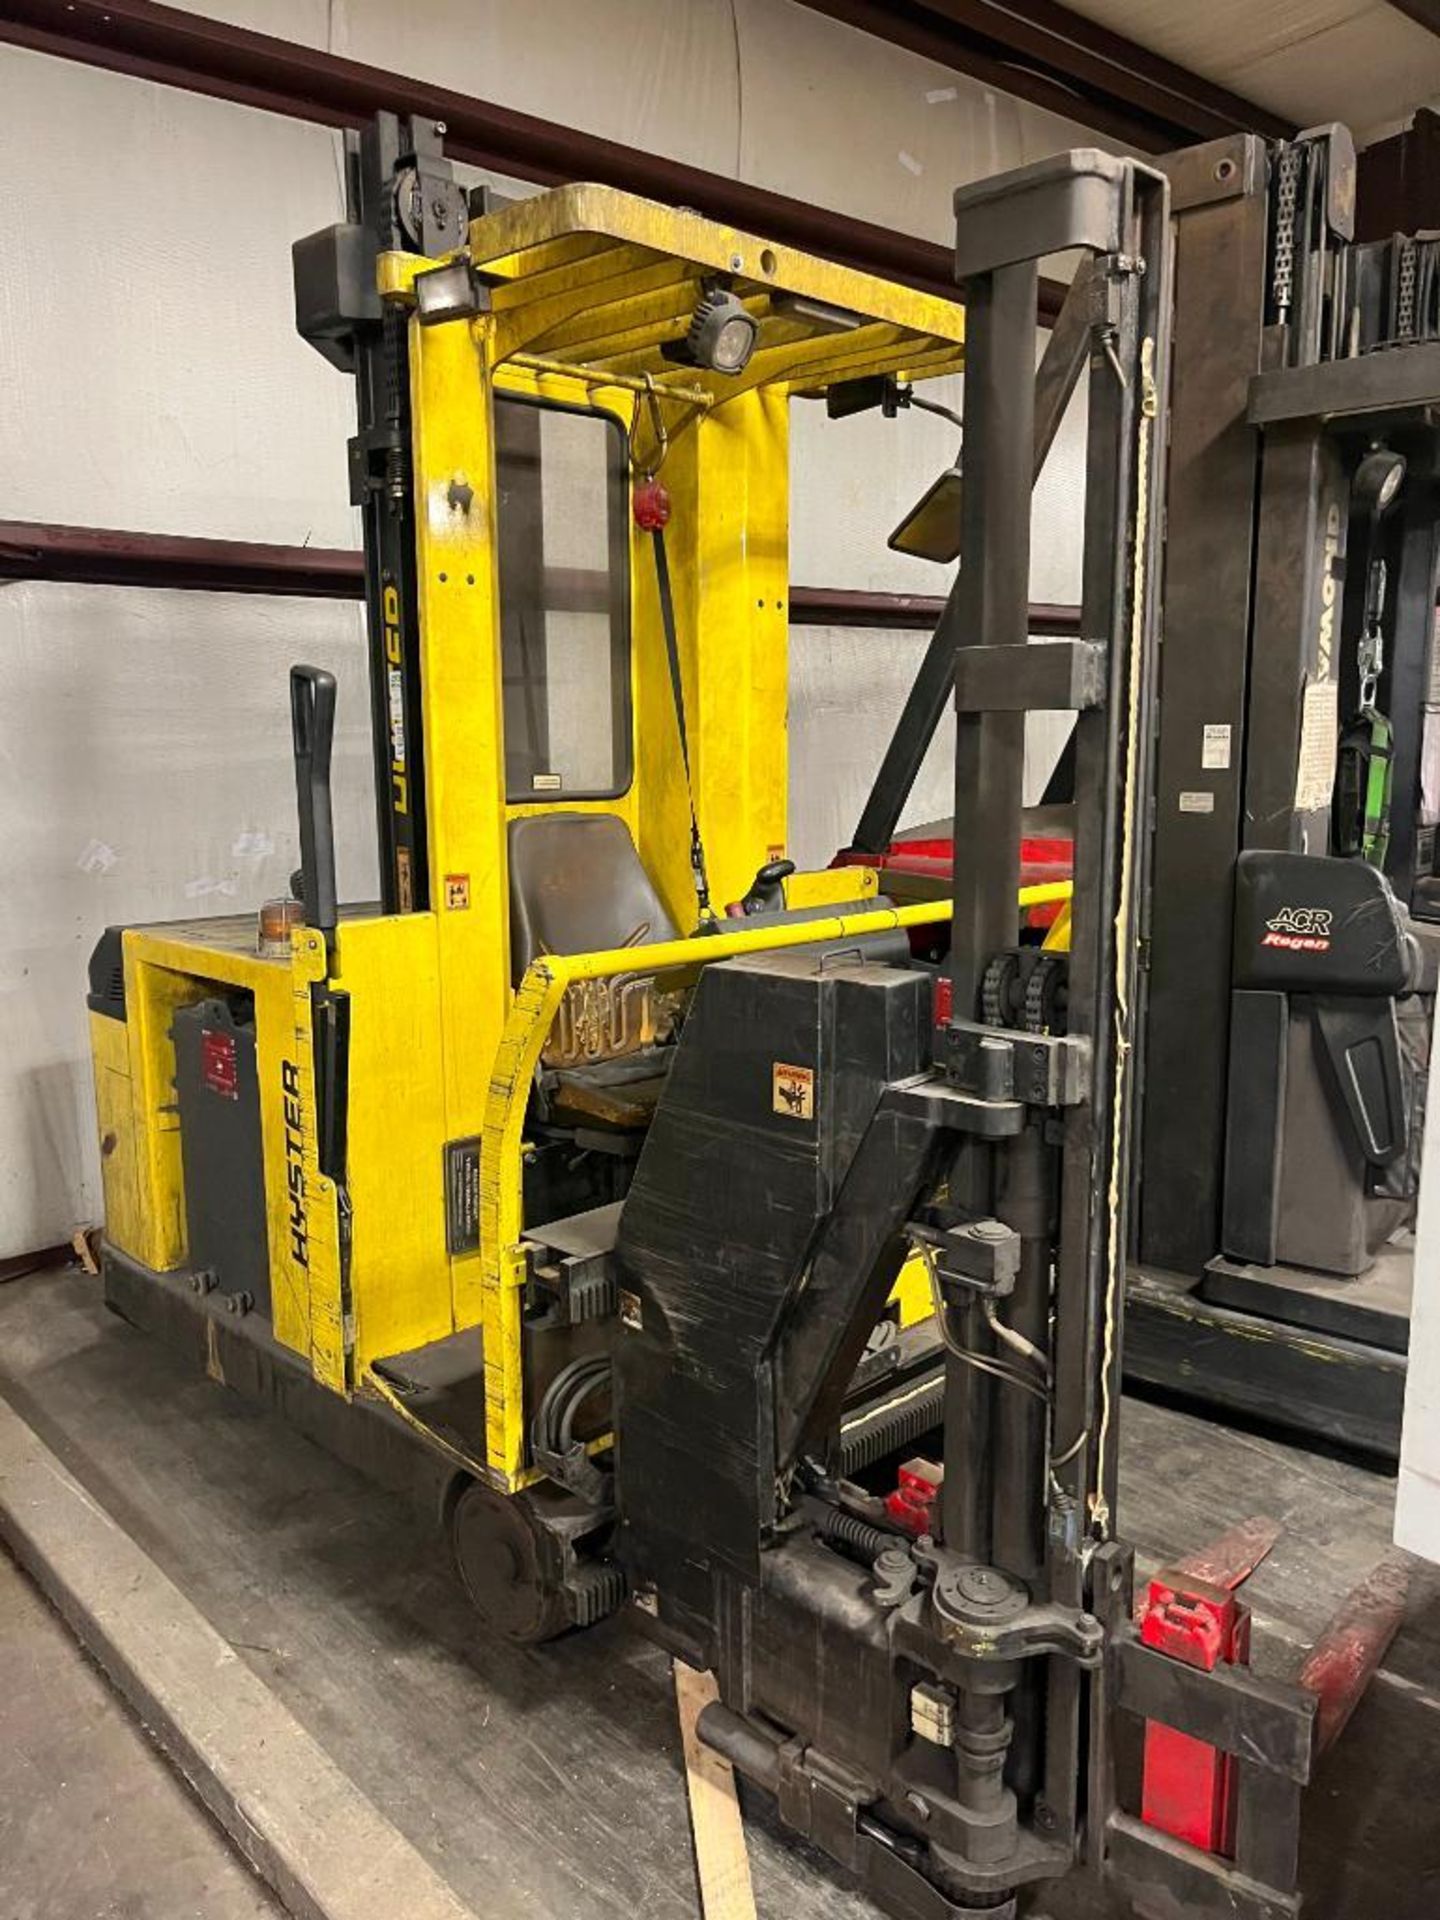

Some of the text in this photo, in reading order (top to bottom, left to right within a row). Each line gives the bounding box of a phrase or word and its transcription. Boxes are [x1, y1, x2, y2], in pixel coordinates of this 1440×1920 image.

[1265, 907, 1333, 936] ACR
[1261, 933, 1330, 951] Regen
[282, 1059, 308, 1269] HYSTER
